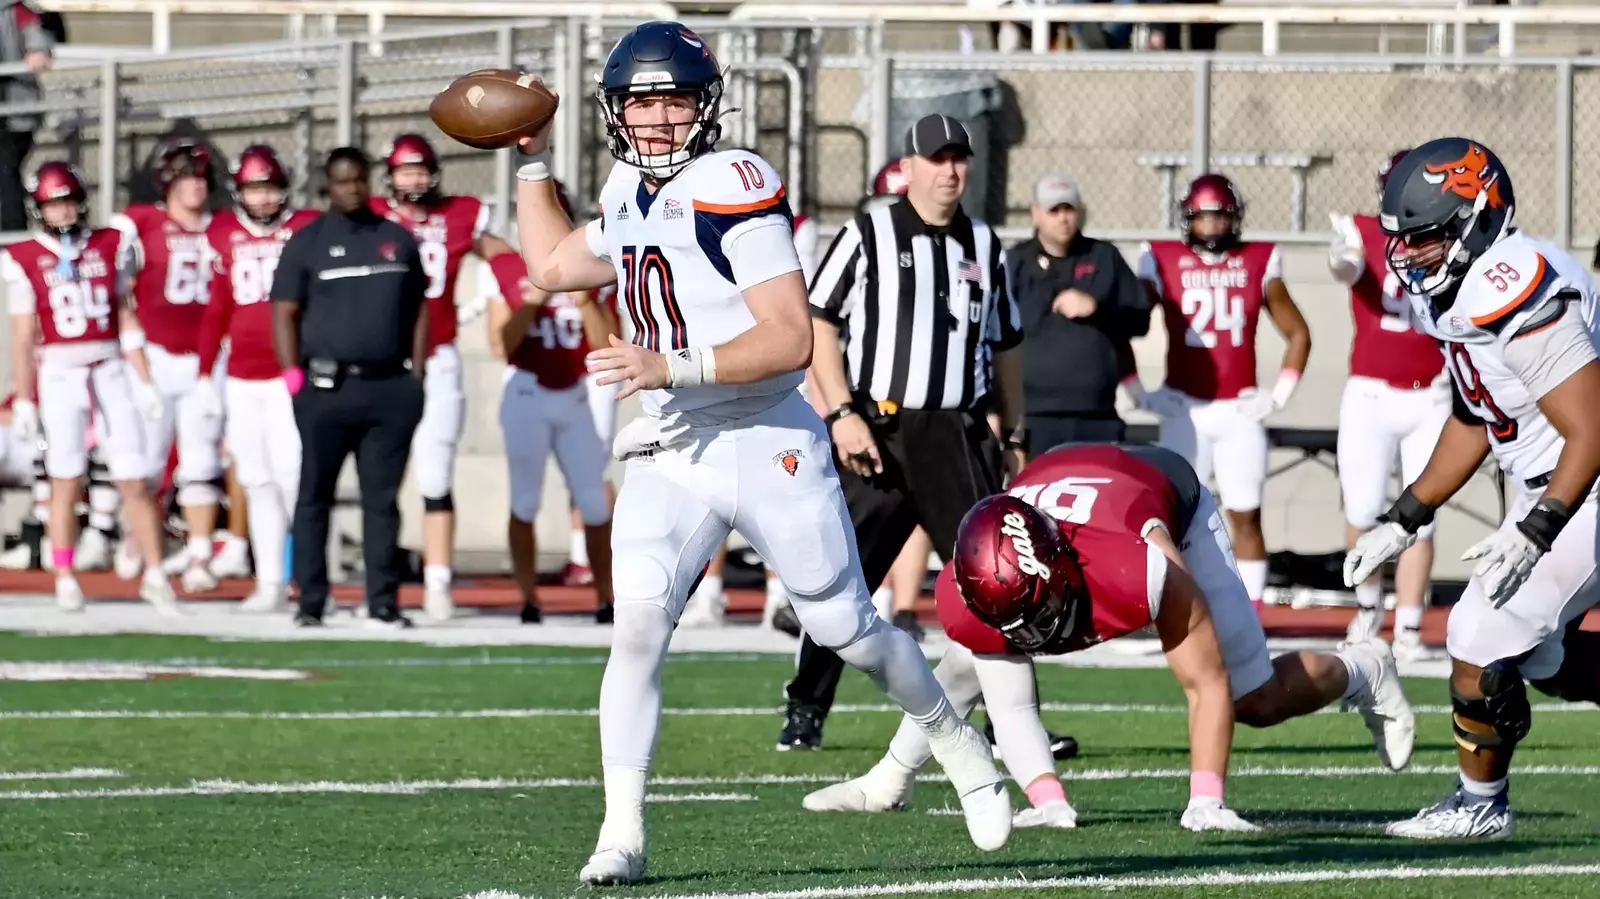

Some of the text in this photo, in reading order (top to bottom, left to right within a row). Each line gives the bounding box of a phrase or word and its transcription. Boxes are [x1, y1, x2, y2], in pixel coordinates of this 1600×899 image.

[731, 160, 765, 191] 10
[899, 251, 912, 268] S
[1484, 262, 1522, 293] 59
[49, 279, 111, 338] 84
[621, 245, 688, 353] 10
[970, 302, 981, 323] U
[1181, 286, 1246, 348] 24
[1001, 511, 1051, 581] gate
